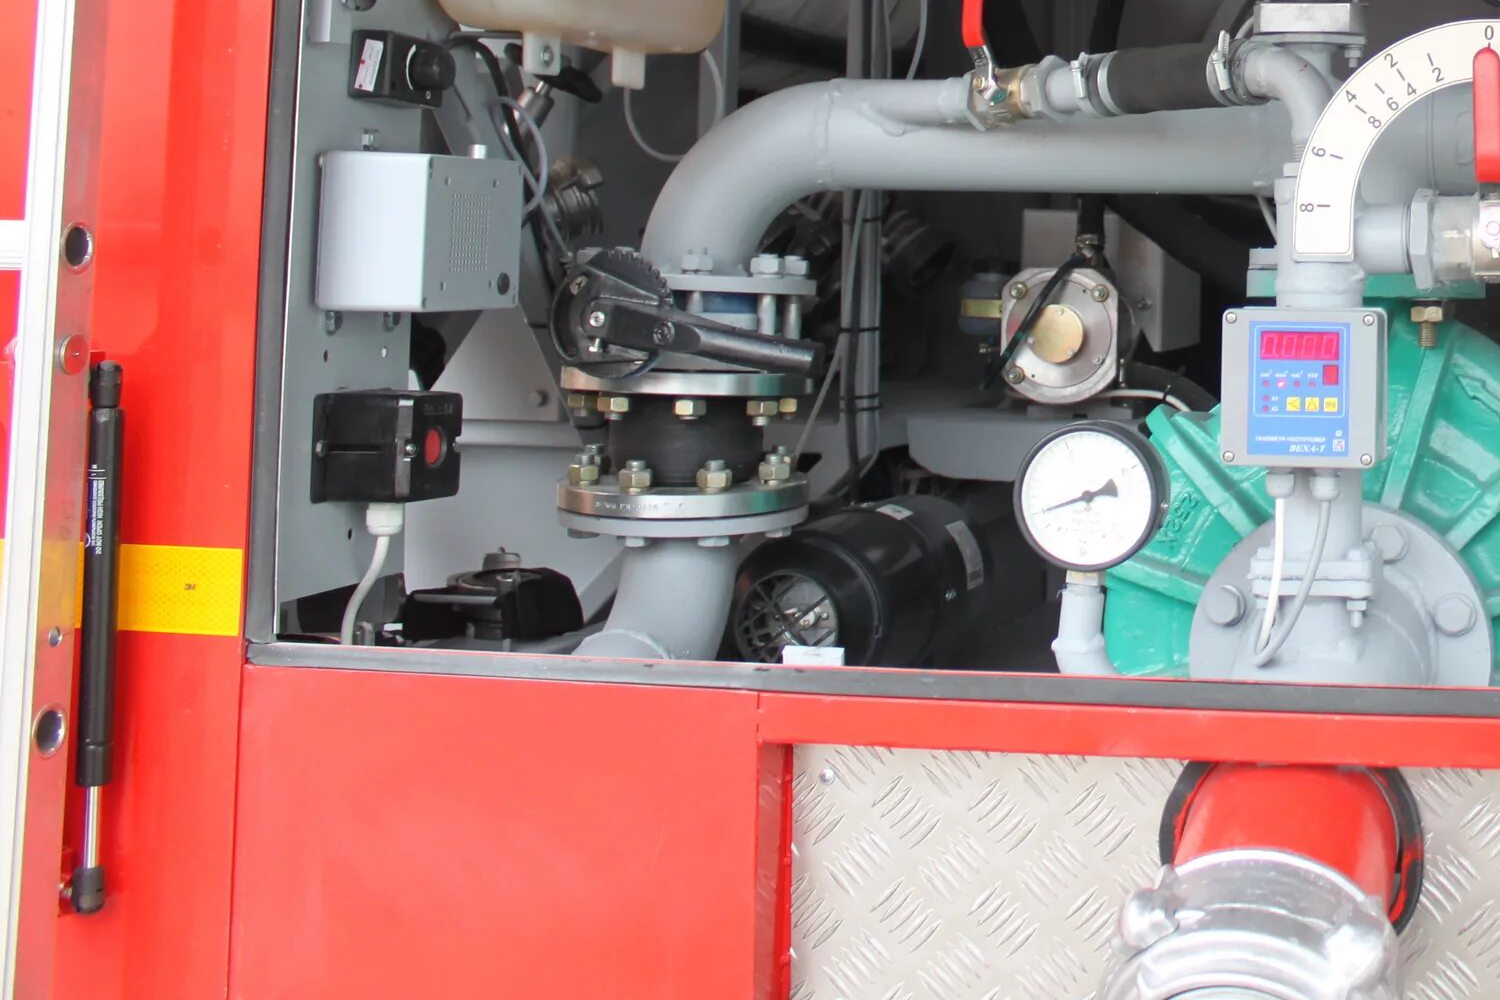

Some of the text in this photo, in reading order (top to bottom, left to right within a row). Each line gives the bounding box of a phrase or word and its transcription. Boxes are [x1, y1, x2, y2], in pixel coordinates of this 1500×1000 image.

[1484, 25, 1494, 41] 0
[1384, 53, 1398, 68] 2
[1431, 66, 1445, 82] 2
[1345, 89, 1358, 102] 4
[1406, 82, 1418, 96] 4
[1386, 97, 1400, 111] 6
[1367, 115, 1382, 129] 8
[1299, 202, 1314, 212] 8
